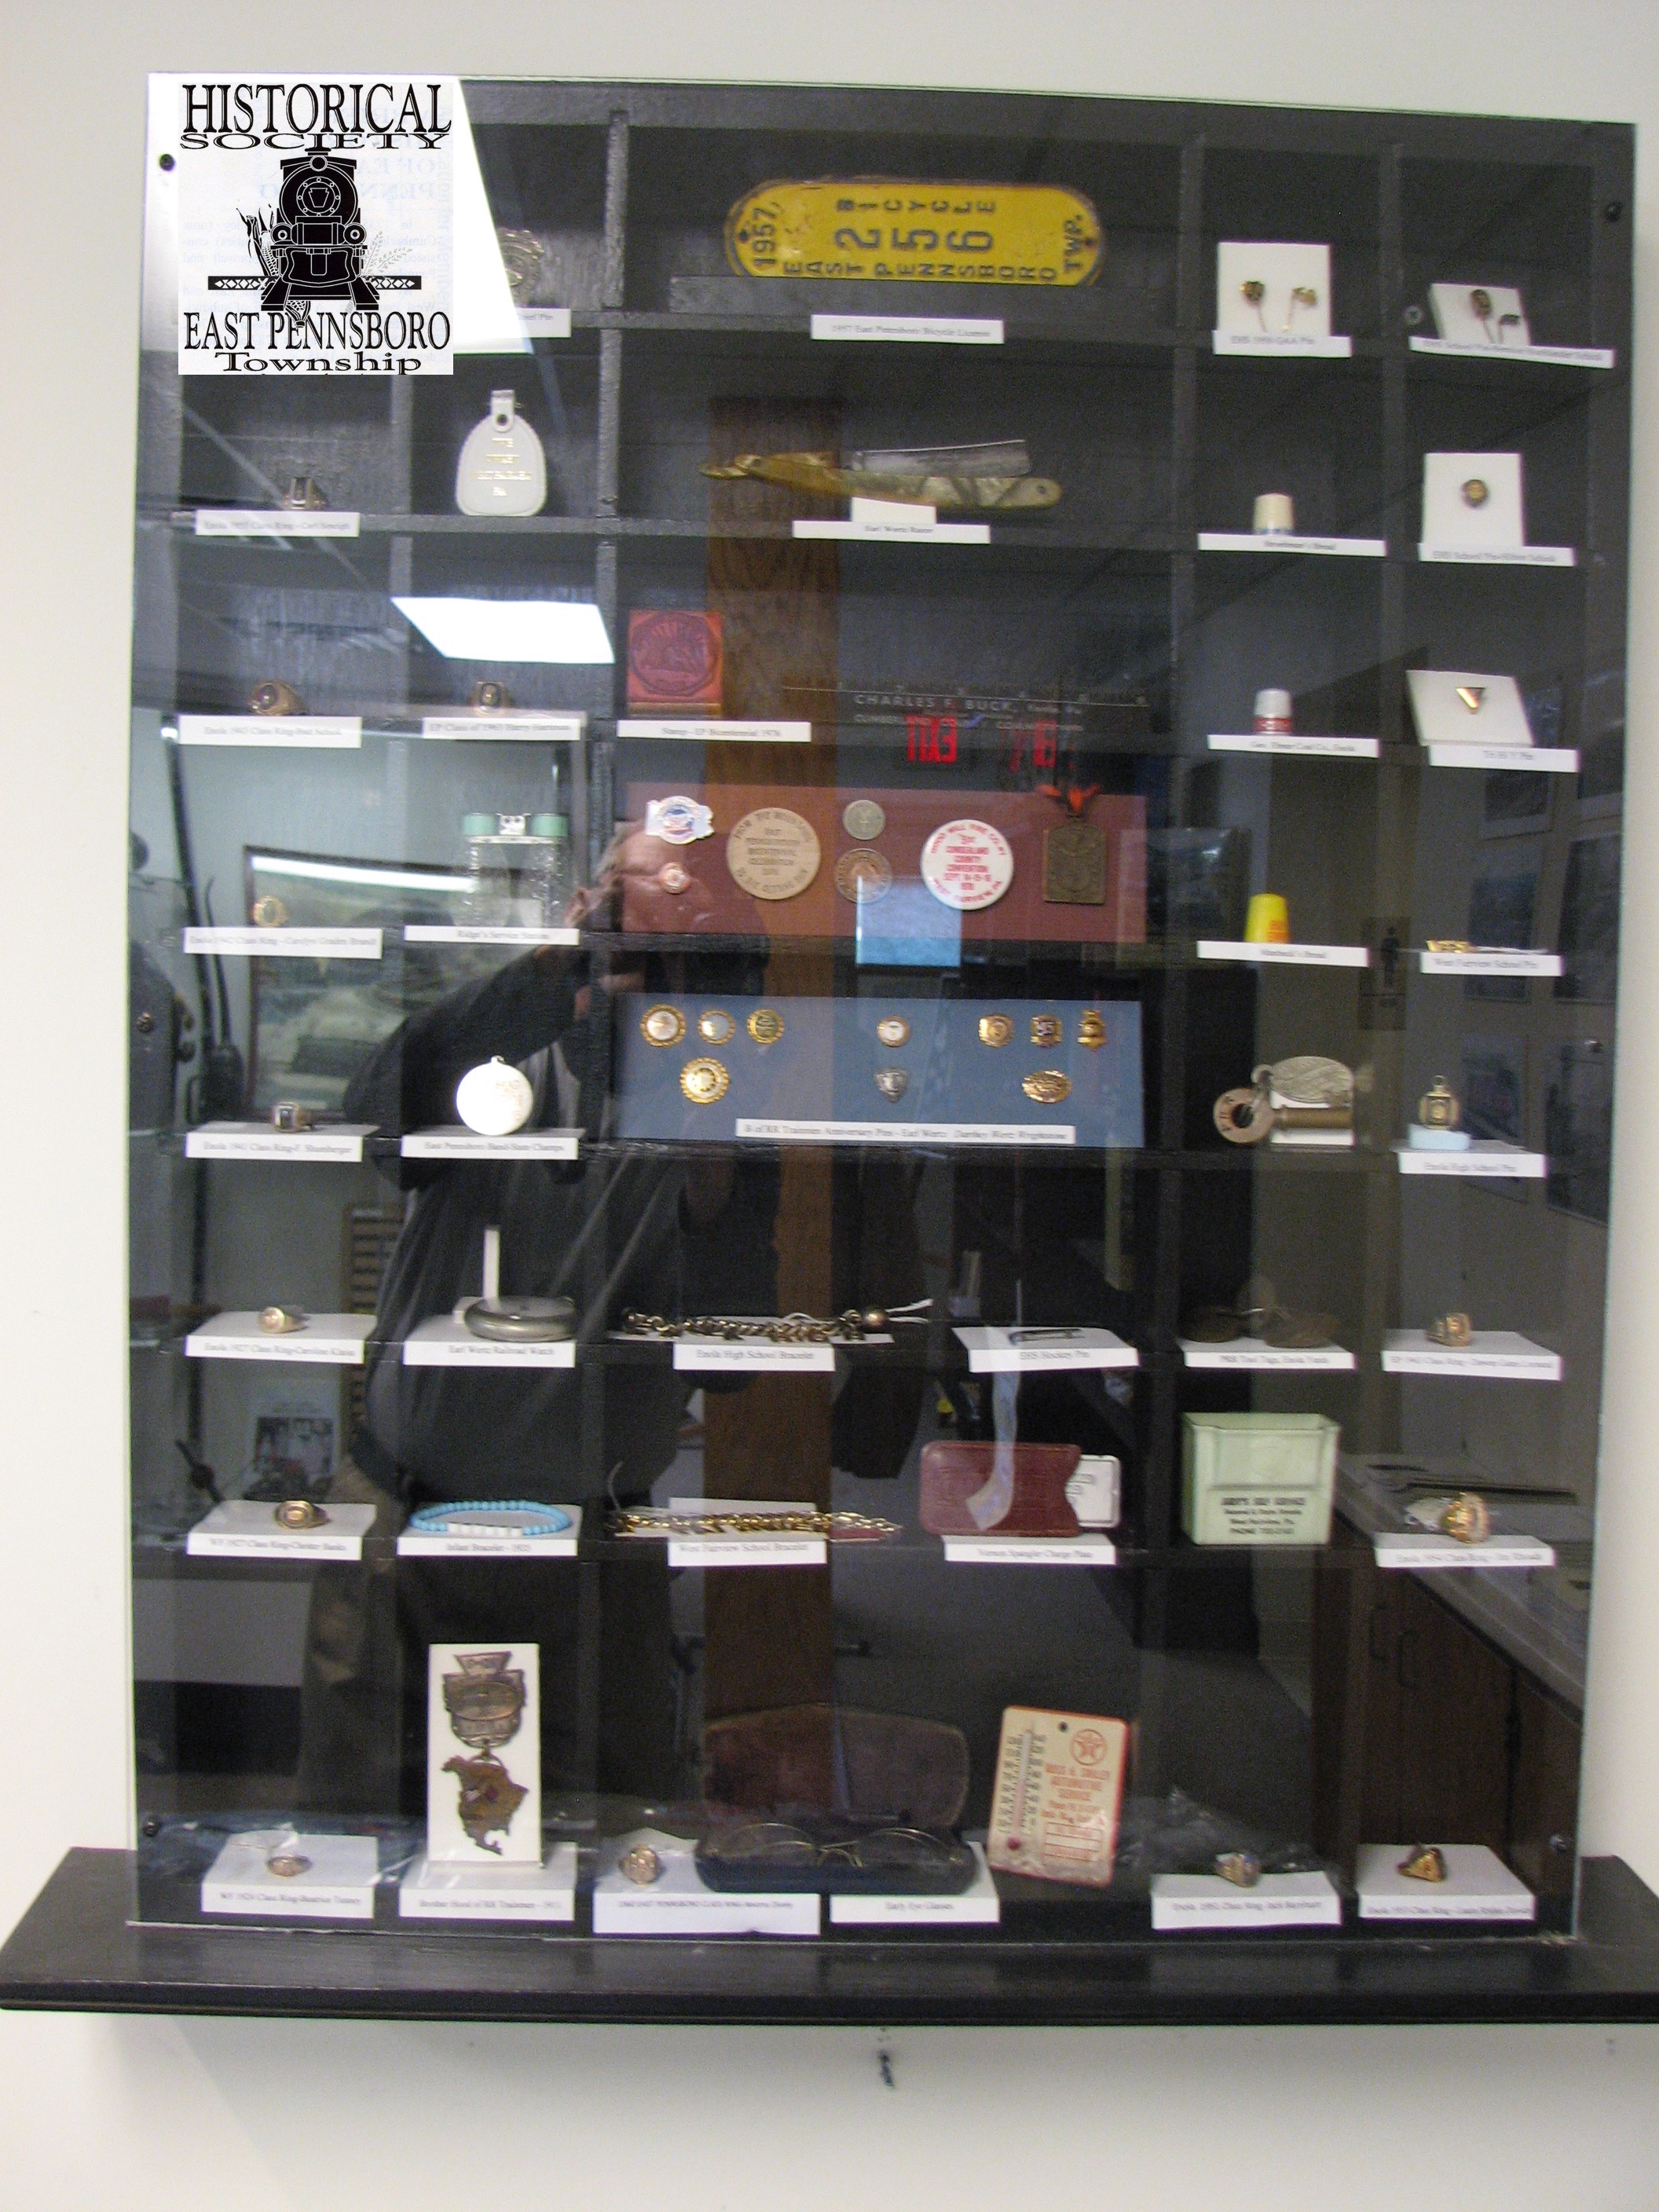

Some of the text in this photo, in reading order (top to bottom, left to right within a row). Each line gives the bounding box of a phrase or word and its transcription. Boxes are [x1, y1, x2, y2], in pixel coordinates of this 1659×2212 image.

[837, 200, 995, 214] BICYCLE
[753, 207, 776, 266] 1957
[836, 228, 994, 253] 256
[783, 261, 1057, 281] EAST PENNSBORO
[855, 694, 934, 707] CHARLES
